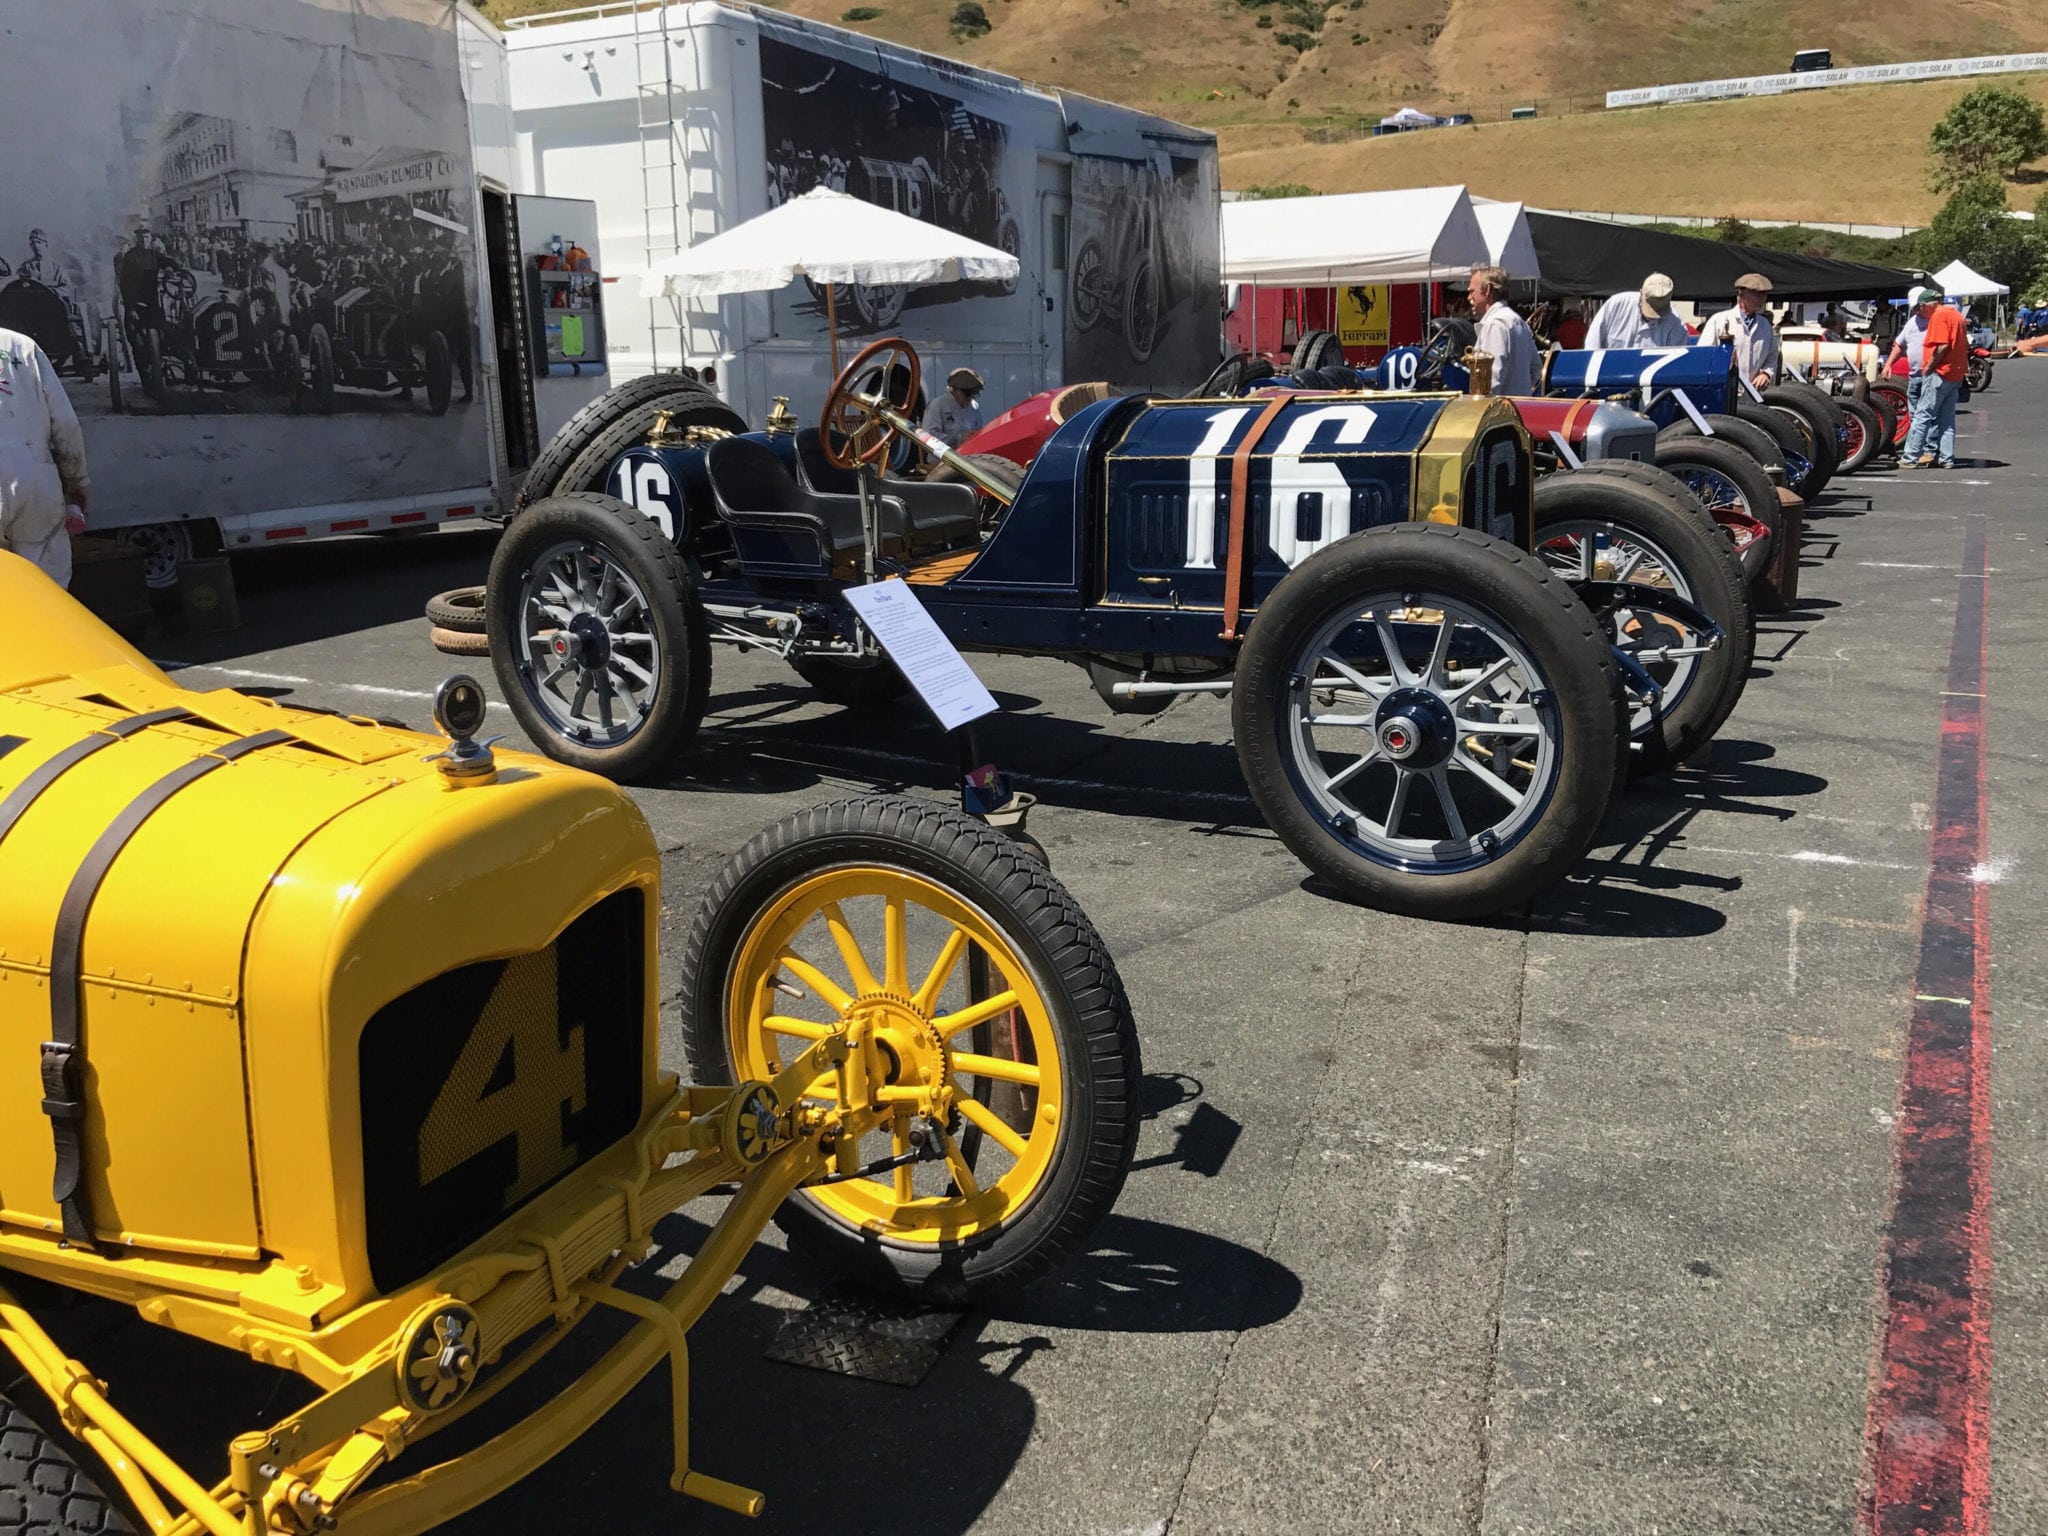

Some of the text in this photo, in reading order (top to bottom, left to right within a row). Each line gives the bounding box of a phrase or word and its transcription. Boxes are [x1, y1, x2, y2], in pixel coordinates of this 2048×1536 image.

[1981, 59, 2005, 69] SOLAR
[2035, 56, 2048, 65] SOL
[1877, 68, 1900, 77] SOLAR
[1929, 63, 1953, 73] SOLAR
[1775, 76, 1798, 86] SOLAR
[1825, 72, 1848, 81] SOLAR
[1677, 86, 1699, 96] SOLAR
[1726, 81, 1748, 91] SOLAR
[1630, 91, 1652, 101] SOLAR
[213, 311, 243, 361] 2
[1343, 330, 1387, 342] Ferrari
[1387, 352, 1418, 390] 19
[1584, 348, 1689, 407] 17
[1184, 404, 1378, 570] 16
[617, 458, 674, 540] 16
[418, 938, 587, 1209] 4
